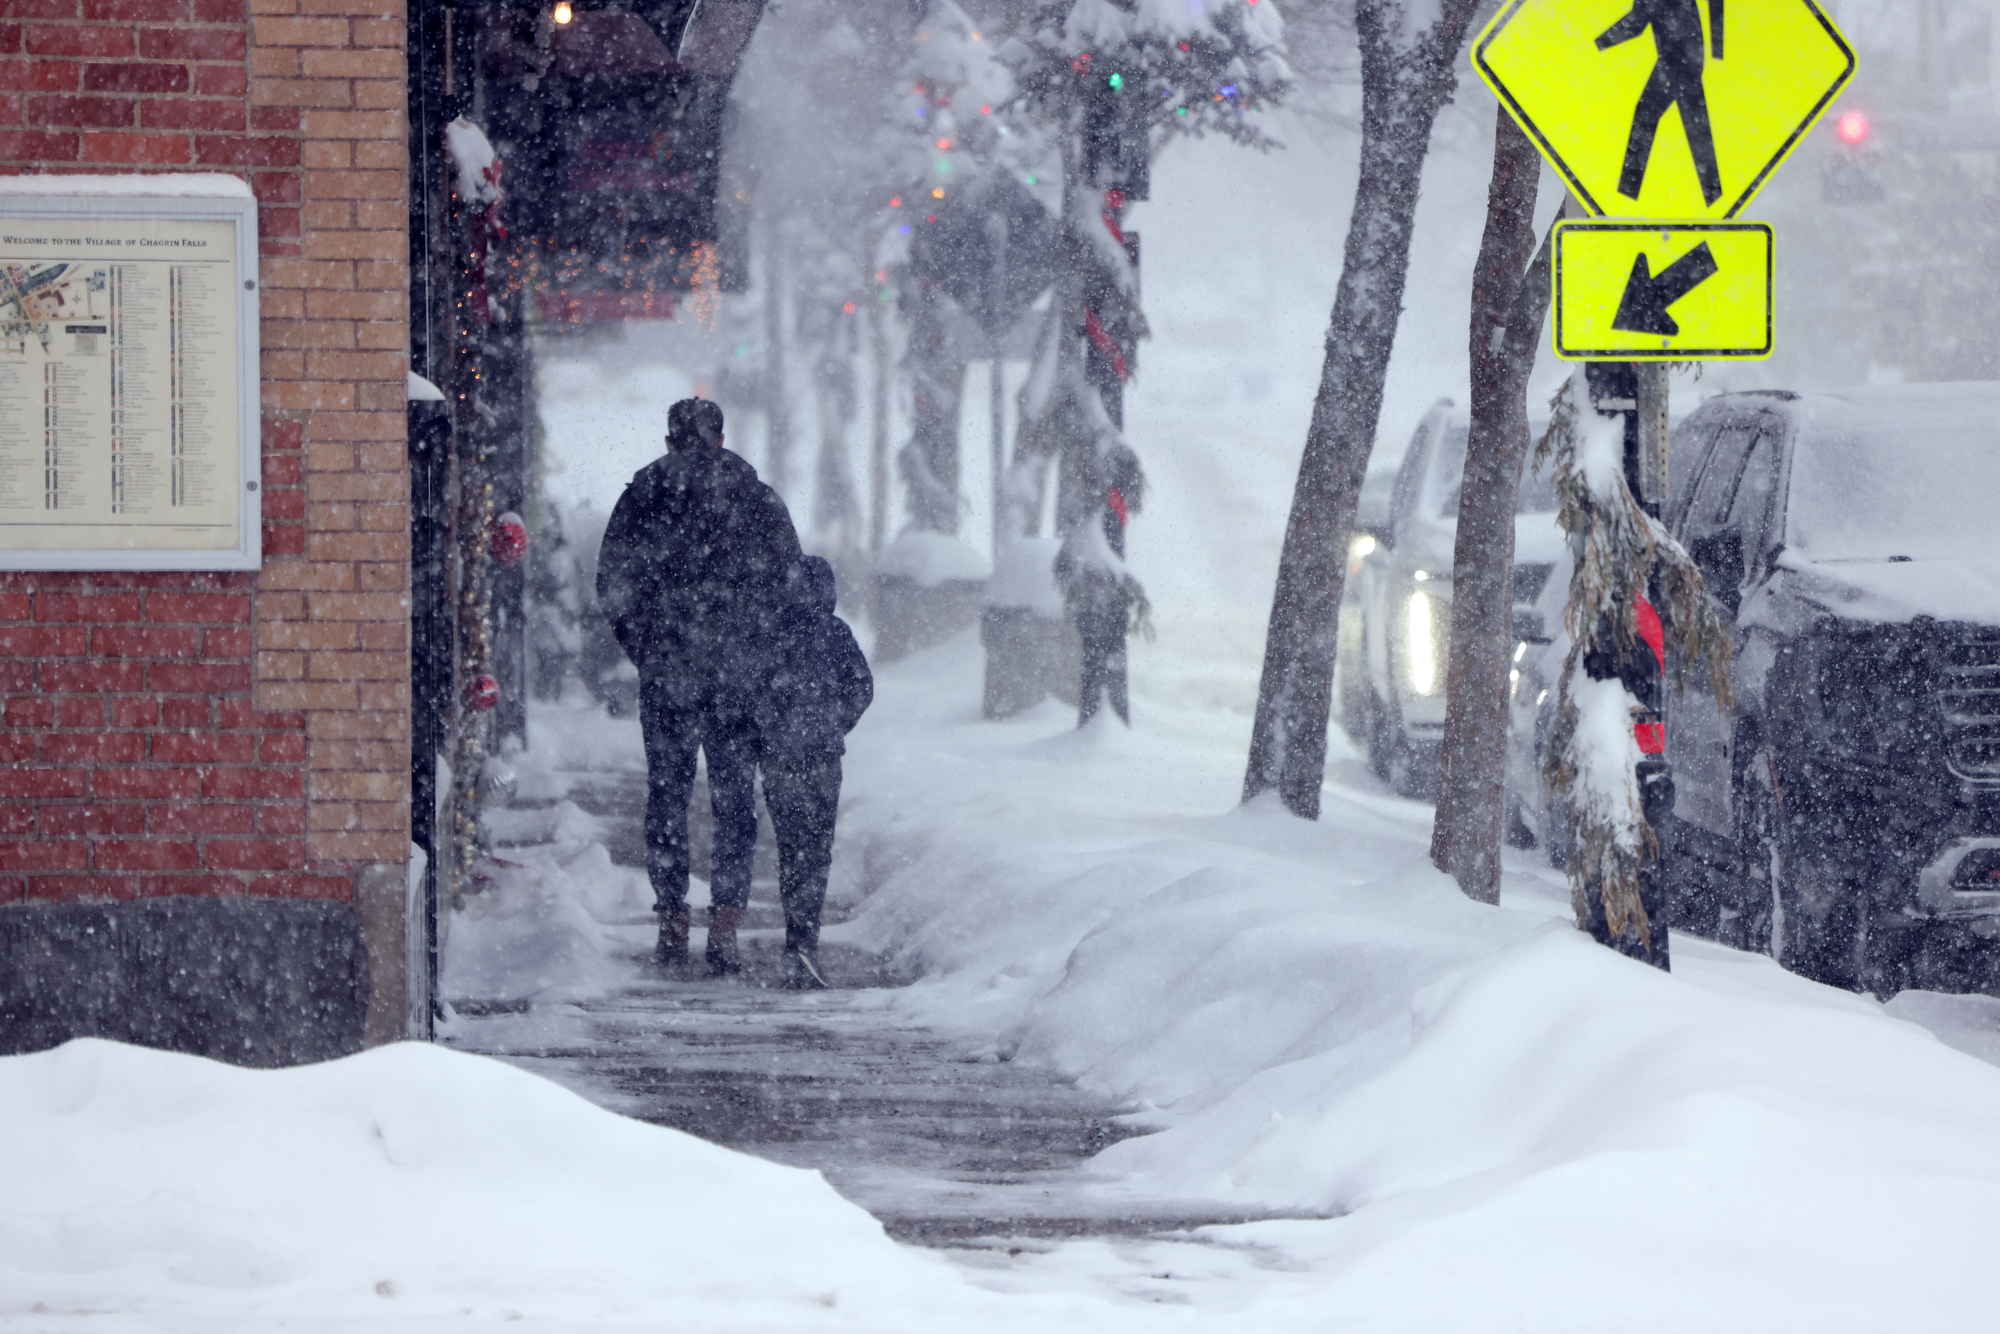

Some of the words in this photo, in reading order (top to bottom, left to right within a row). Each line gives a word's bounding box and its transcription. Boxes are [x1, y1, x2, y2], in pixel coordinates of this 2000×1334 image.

[3, 236, 48, 245] WELCOME
[52, 238, 63, 246] TO
[65, 238, 82, 246] THE
[85, 237, 122, 247] VILLAGE
[125, 239, 137, 247] OF
[139, 239, 180, 247] CHAGRIN
[182, 239, 207, 247] FALLS
